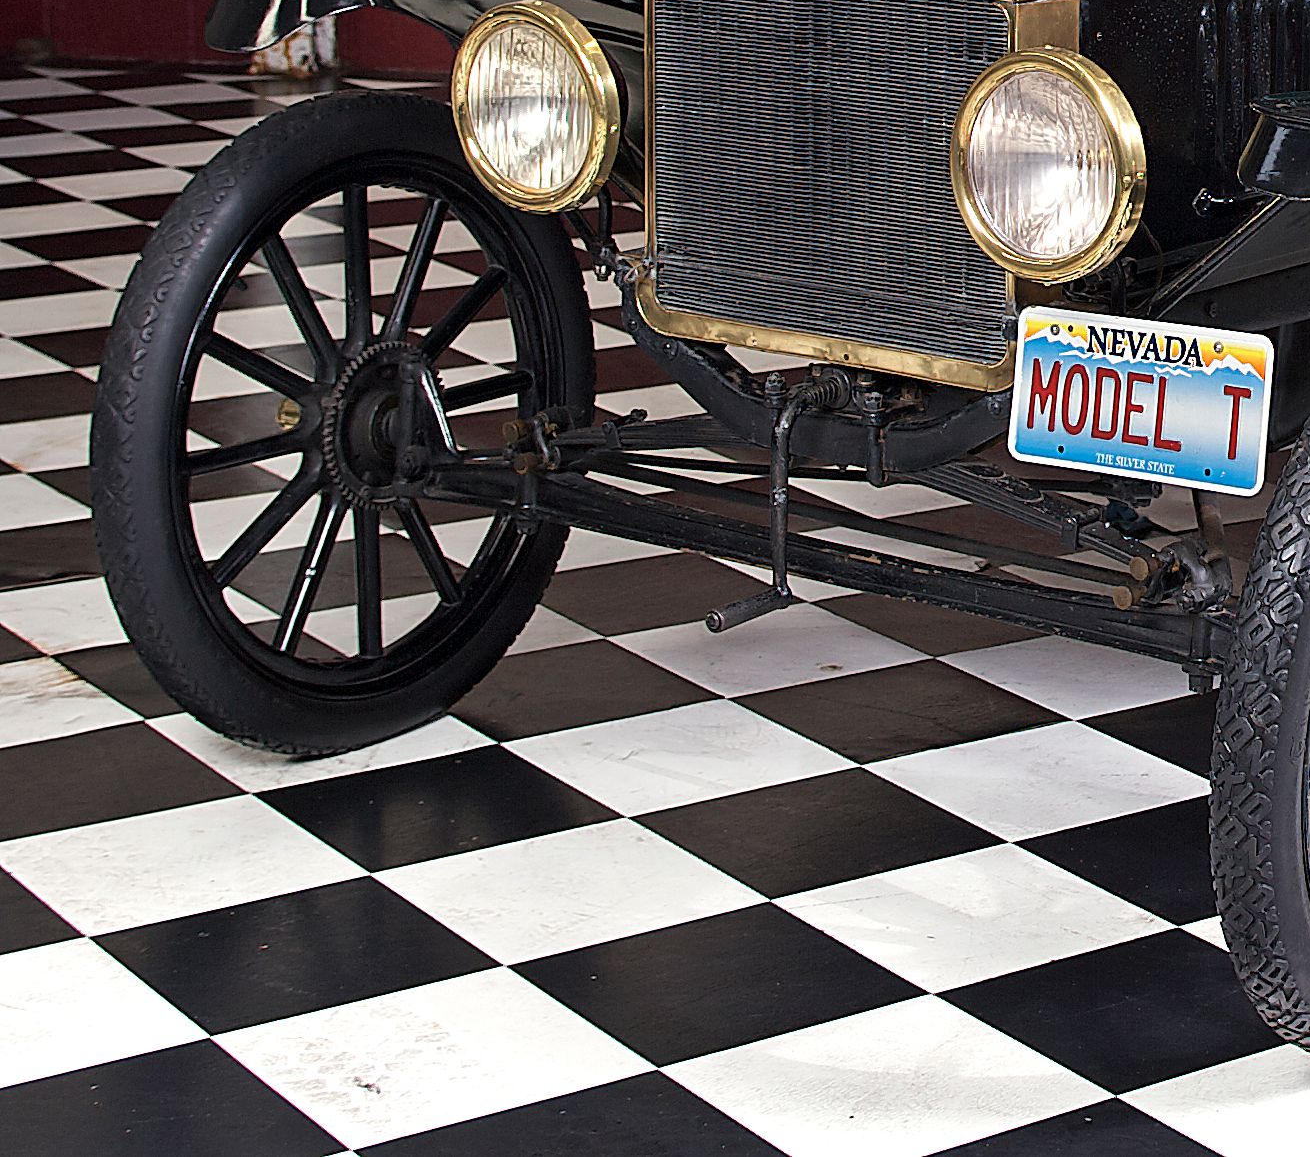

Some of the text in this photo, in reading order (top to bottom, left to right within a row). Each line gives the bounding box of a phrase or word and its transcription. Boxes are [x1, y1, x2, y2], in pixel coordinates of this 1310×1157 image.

[1086, 325, 1203, 369] NEVADA
[1026, 357, 1252, 460] MODEL T
[1095, 452, 1176, 476] THE SILVER STATE
